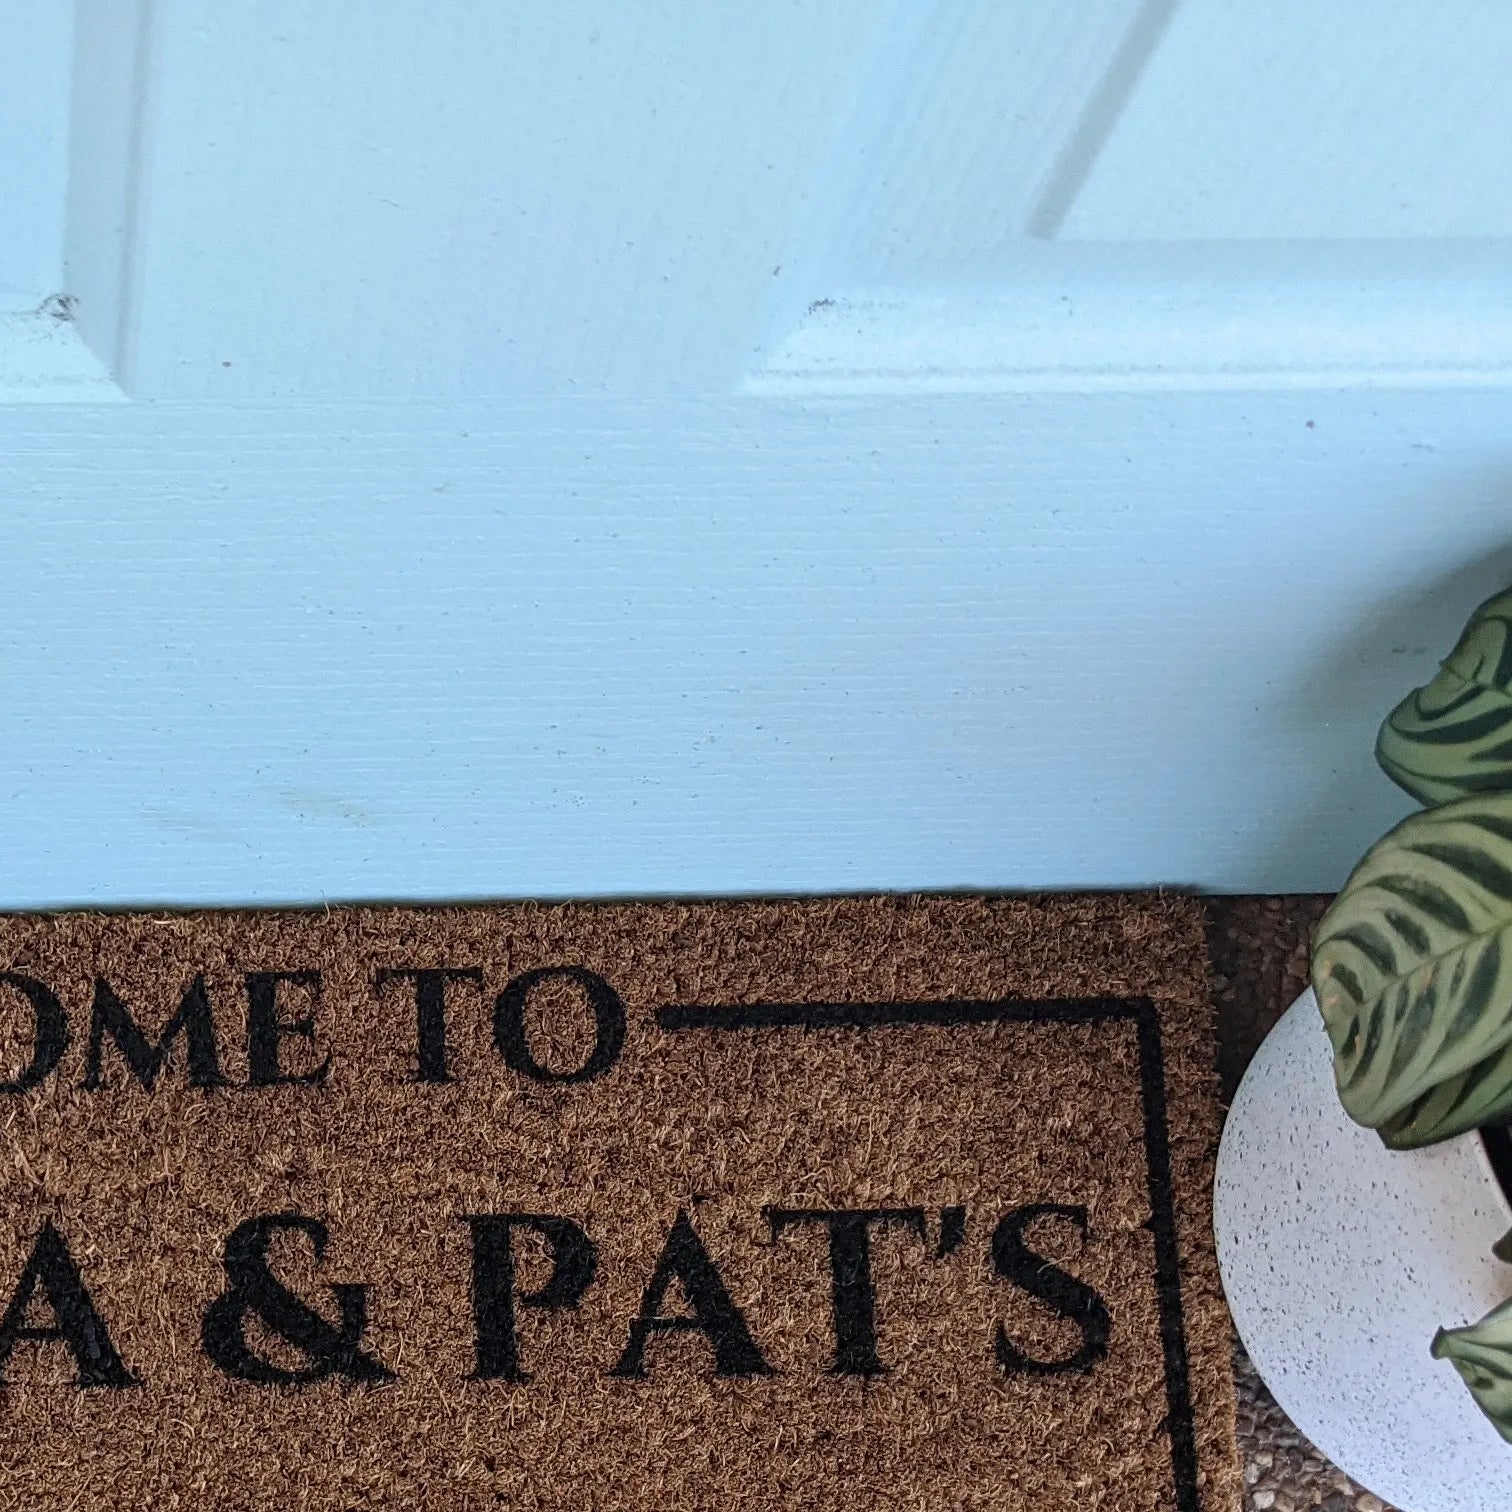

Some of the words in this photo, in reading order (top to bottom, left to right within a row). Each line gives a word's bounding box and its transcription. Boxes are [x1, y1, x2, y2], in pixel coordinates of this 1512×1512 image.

[380, 962, 628, 1086] TO
[199, 1208, 398, 1390] &
[466, 1195, 1116, 1388] PAT'S
